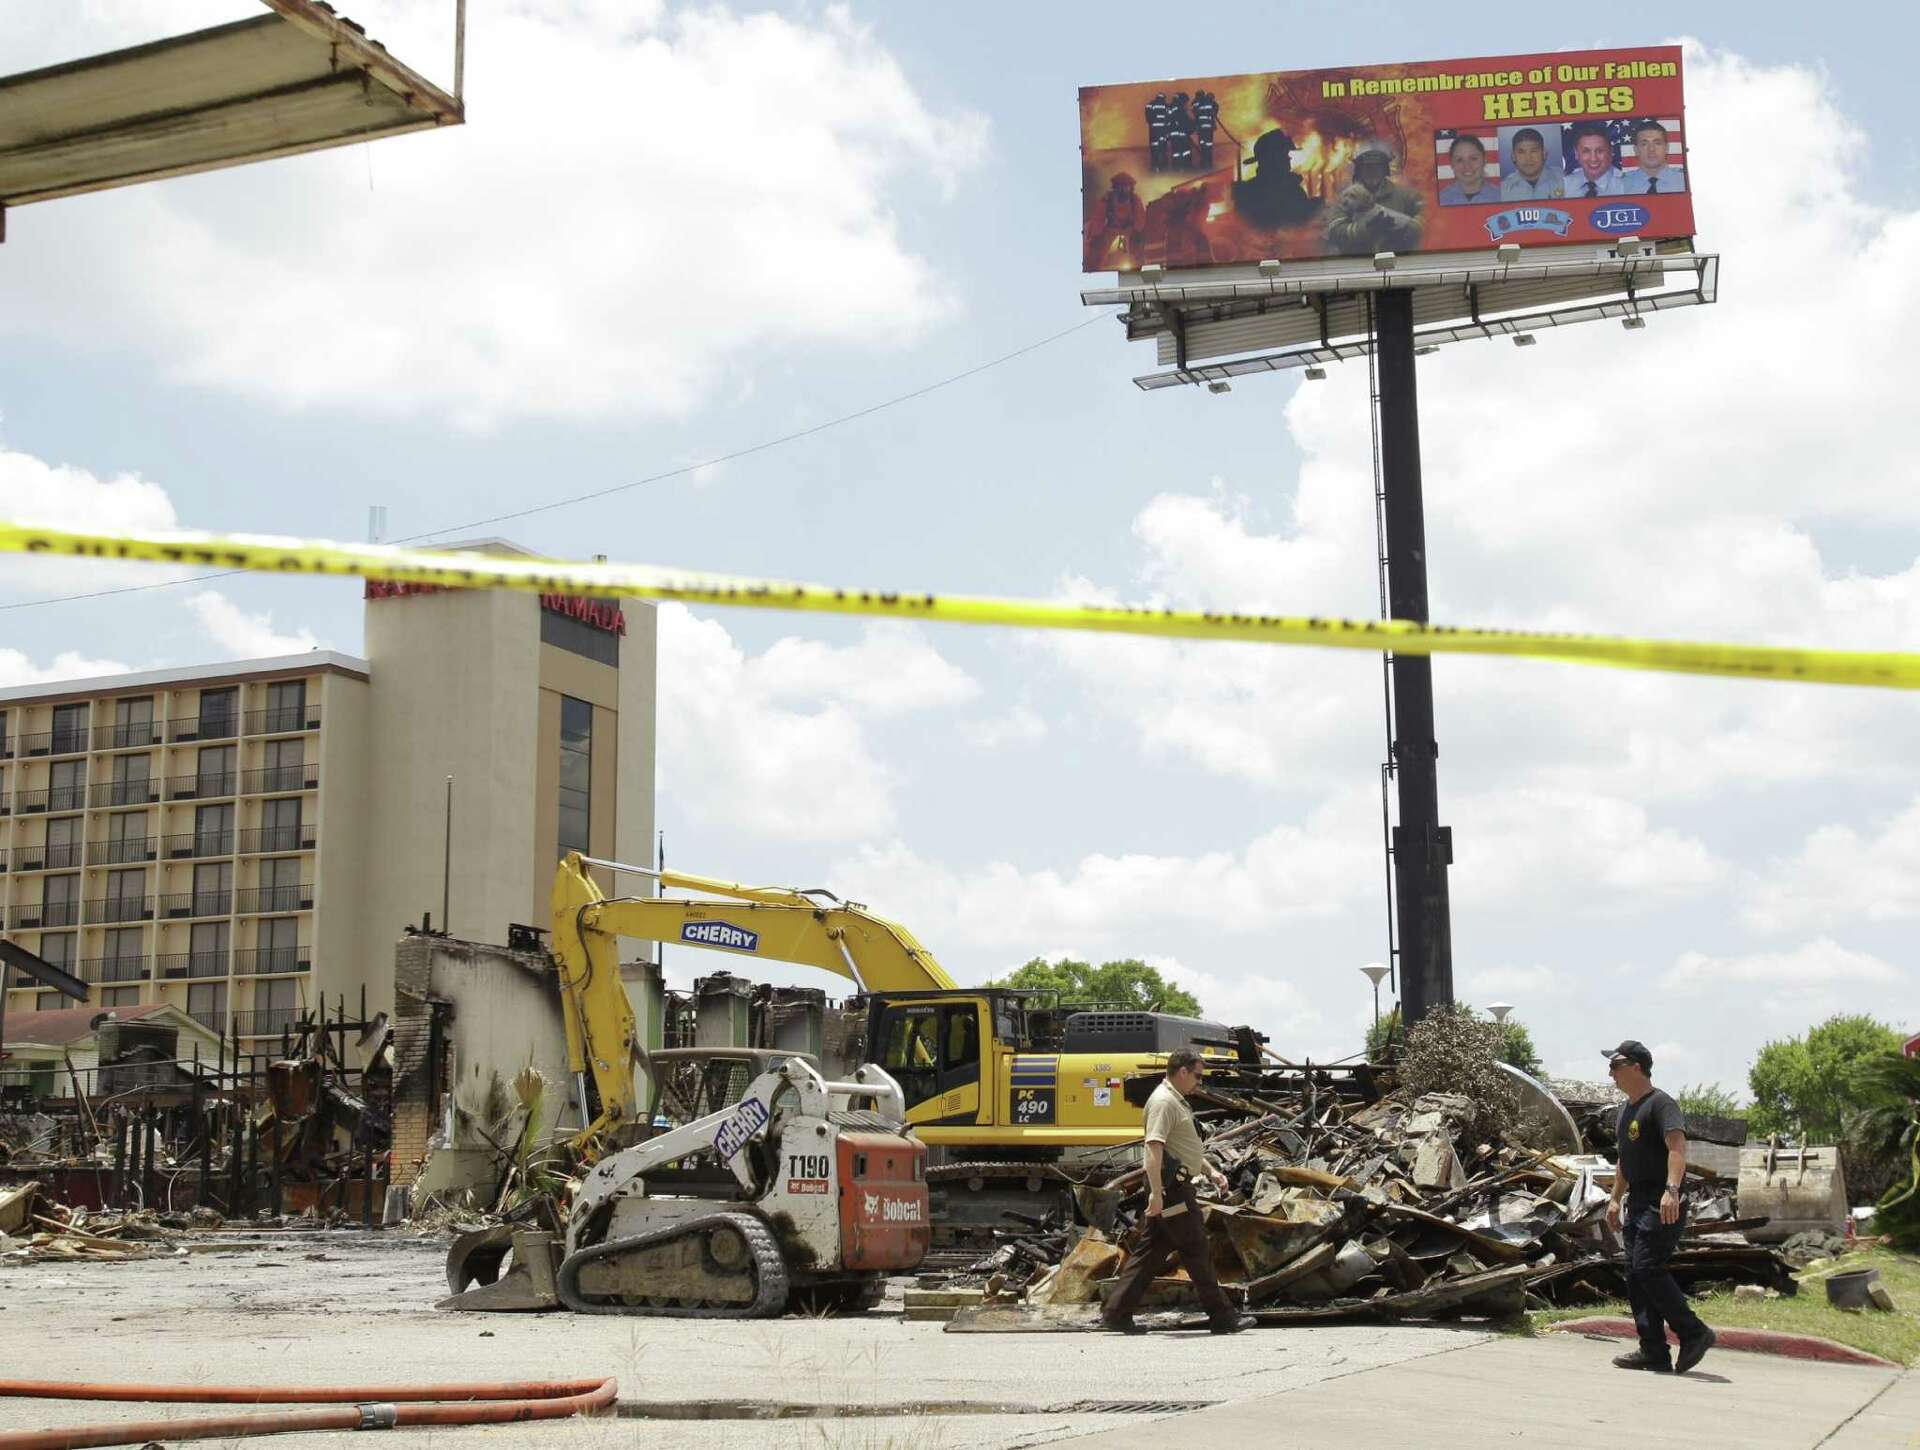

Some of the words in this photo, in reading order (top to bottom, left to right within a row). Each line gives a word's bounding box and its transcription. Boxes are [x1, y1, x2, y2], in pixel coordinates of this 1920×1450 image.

[1322, 80, 1346, 98] In
[1350, 70, 1524, 97] Remembrance
[1528, 66, 1552, 84] of
[1557, 64, 1600, 83] Our
[1604, 60, 1677, 80] Fallen
[1483, 86, 1635, 121] HEROES
[1519, 209, 1540, 222] 100
[685, 924, 754, 947] CHERRY
[1018, 1089, 1035, 1100] PC
[1018, 1100, 1048, 1114] 490
[717, 1101, 767, 1158] CHERRY
[1018, 1115, 1030, 1123] LC
[788, 1155, 830, 1179] T190
[801, 1182, 825, 1193] Bobcat
[883, 1198, 921, 1222] Bobcat
